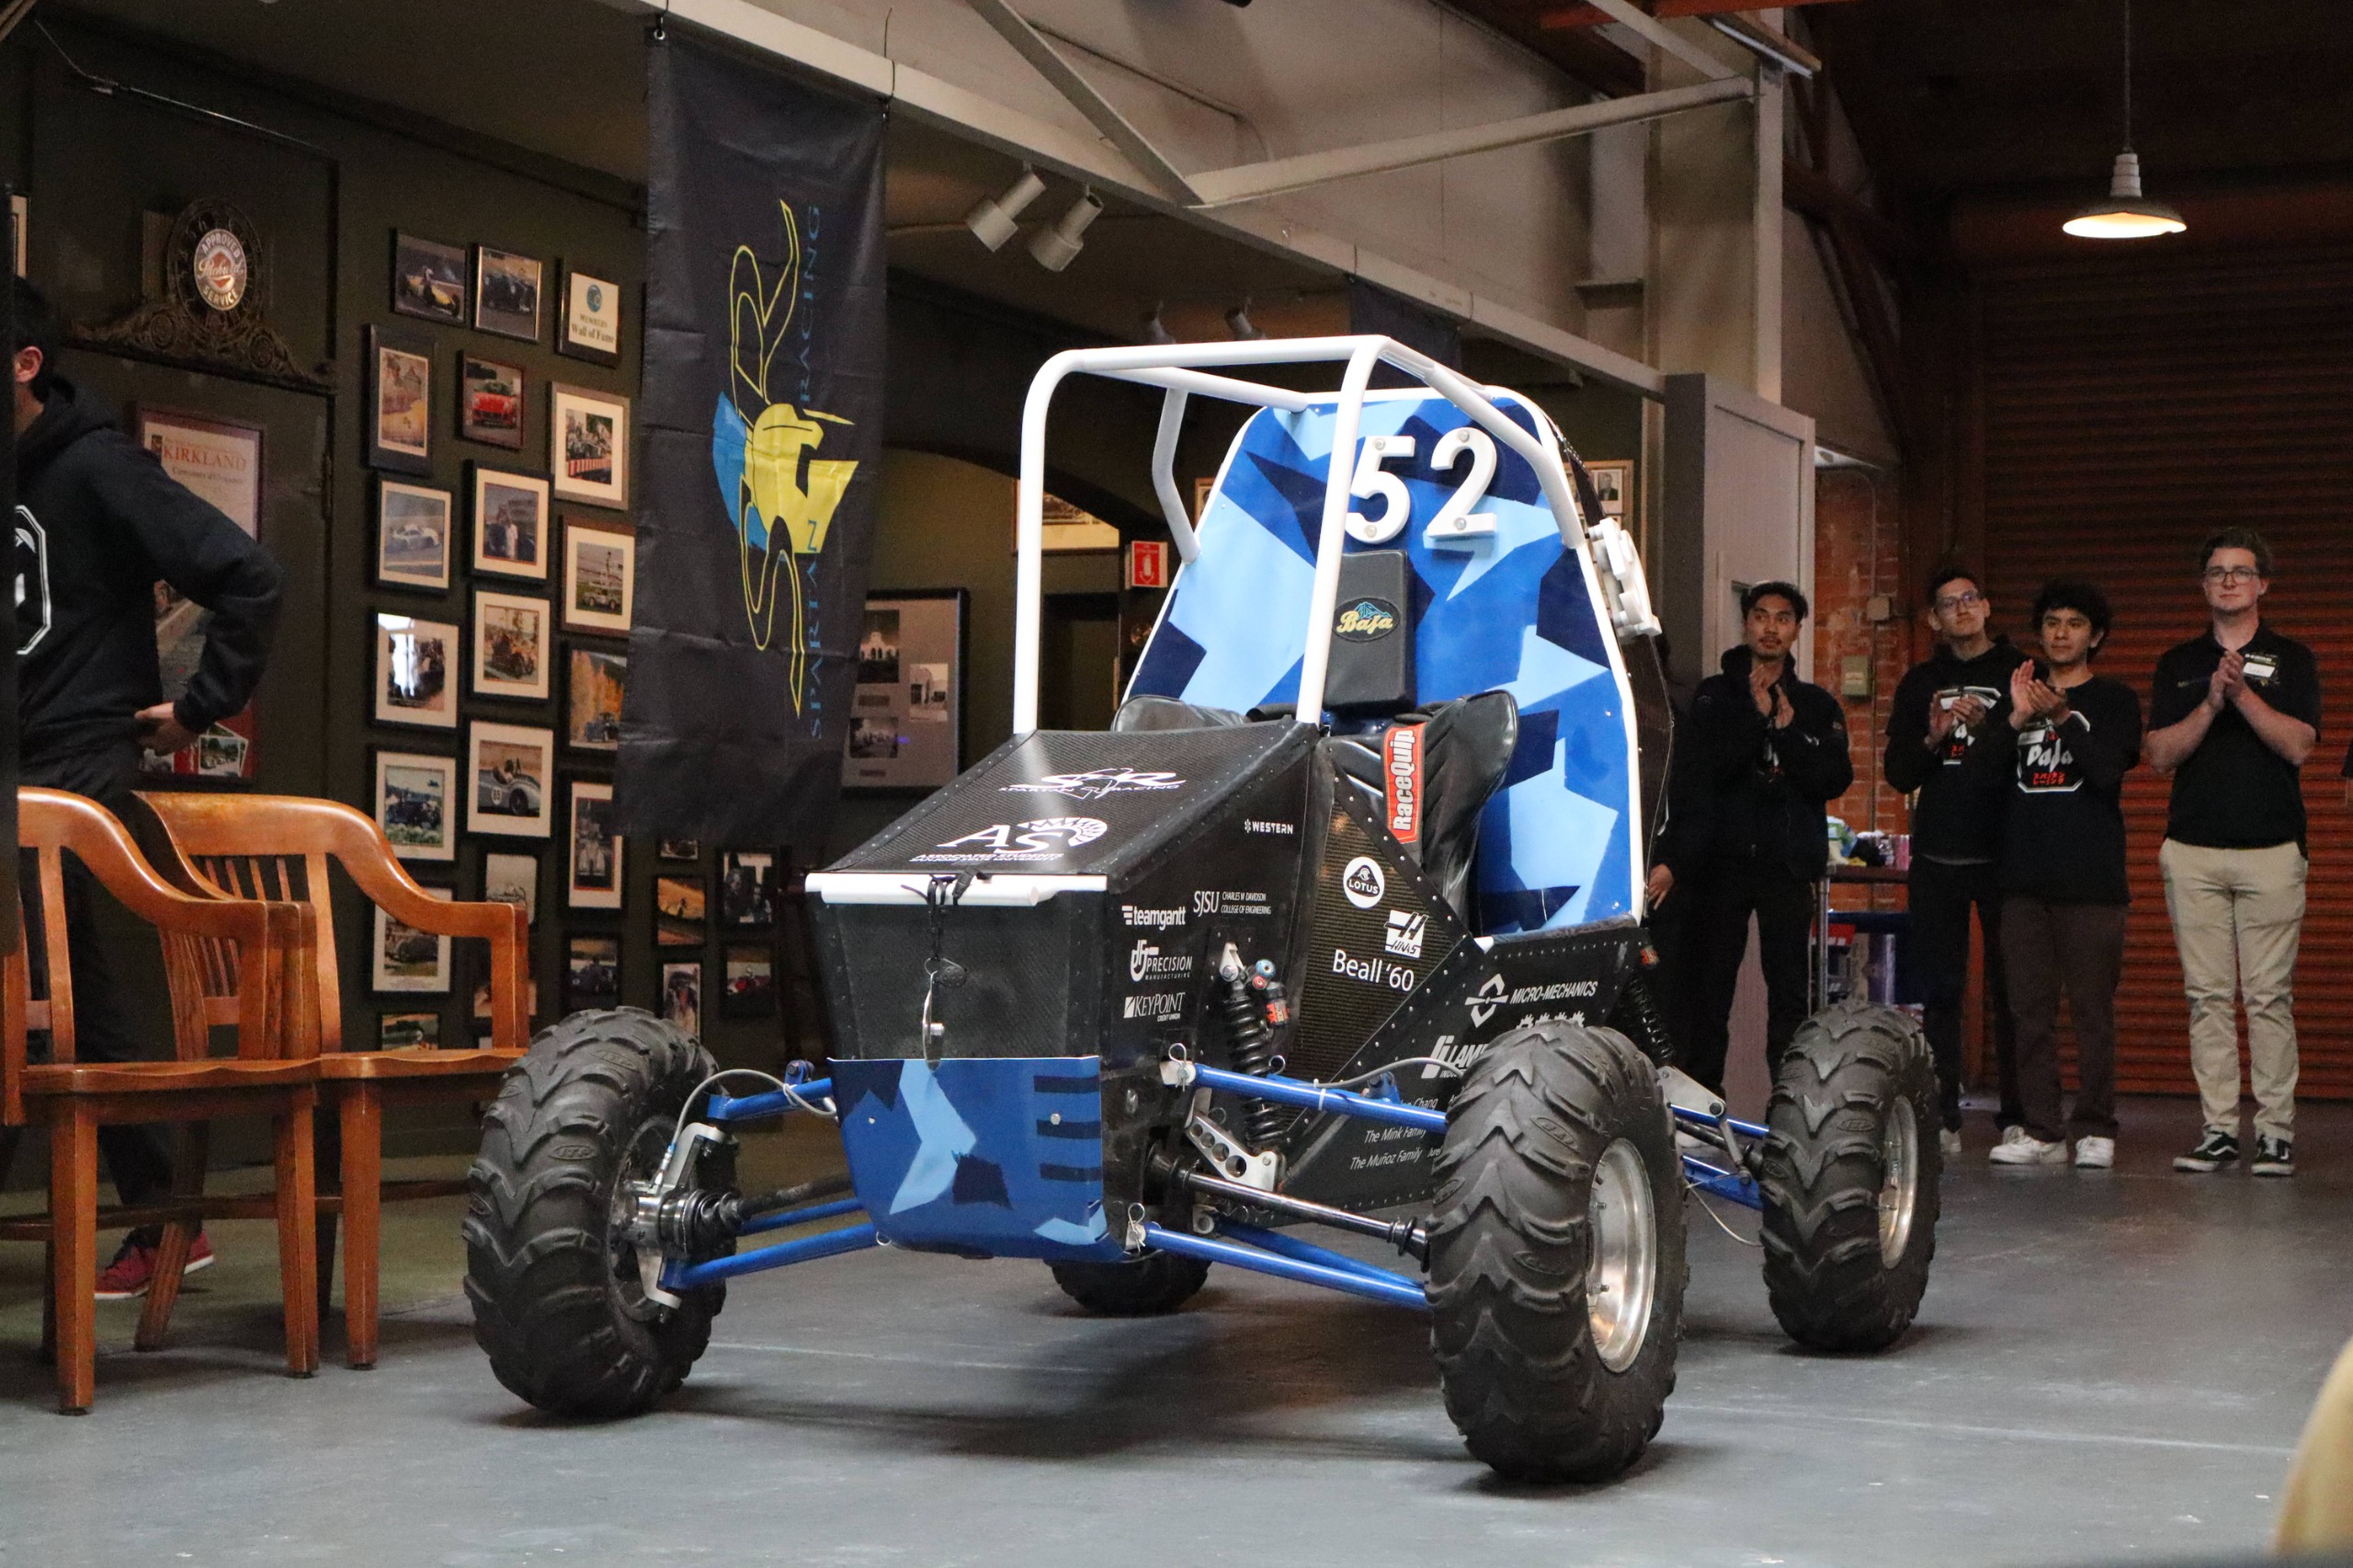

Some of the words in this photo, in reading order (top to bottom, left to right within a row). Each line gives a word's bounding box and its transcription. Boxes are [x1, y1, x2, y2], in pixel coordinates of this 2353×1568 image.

[201, 233, 241, 258] APPROVED
[203, 285, 238, 306] SERVICE
[800, 206, 821, 402] RACING
[571, 324, 587, 337] Wall
[588, 328, 596, 339] of
[164, 446, 247, 472] KIRKLAND
[1345, 426, 1497, 544] 52
[1336, 610, 1393, 634] Baja
[1109, 783, 1180, 792] RACING
[1390, 730, 1415, 831] RaceQuip
[1252, 821, 1293, 835] WESTERN
[1349, 879, 1379, 894] LOTUS
[1194, 891, 1220, 916] SJSU
[1222, 892, 1240, 901] CHARLES
[1221, 904, 1239, 914] COLLEGE
[1245, 905, 1271, 915] ENGINEERING
[1133, 905, 1186, 930] teamgantt
[1145, 956, 1192, 973] PRECISION
[1145, 971, 1190, 981] MANUFACTURING
[1333, 949, 1382, 983] Beall
[1510, 981, 1598, 1005] MICRO-MECHANICS
[1364, 1130, 1380, 1144] The
[1381, 1128, 1402, 1142] Mink
[1349, 1156, 1366, 1170] The
[1366, 1151, 1395, 1168] Muñoz
[1396, 1148, 1423, 1165] Family
